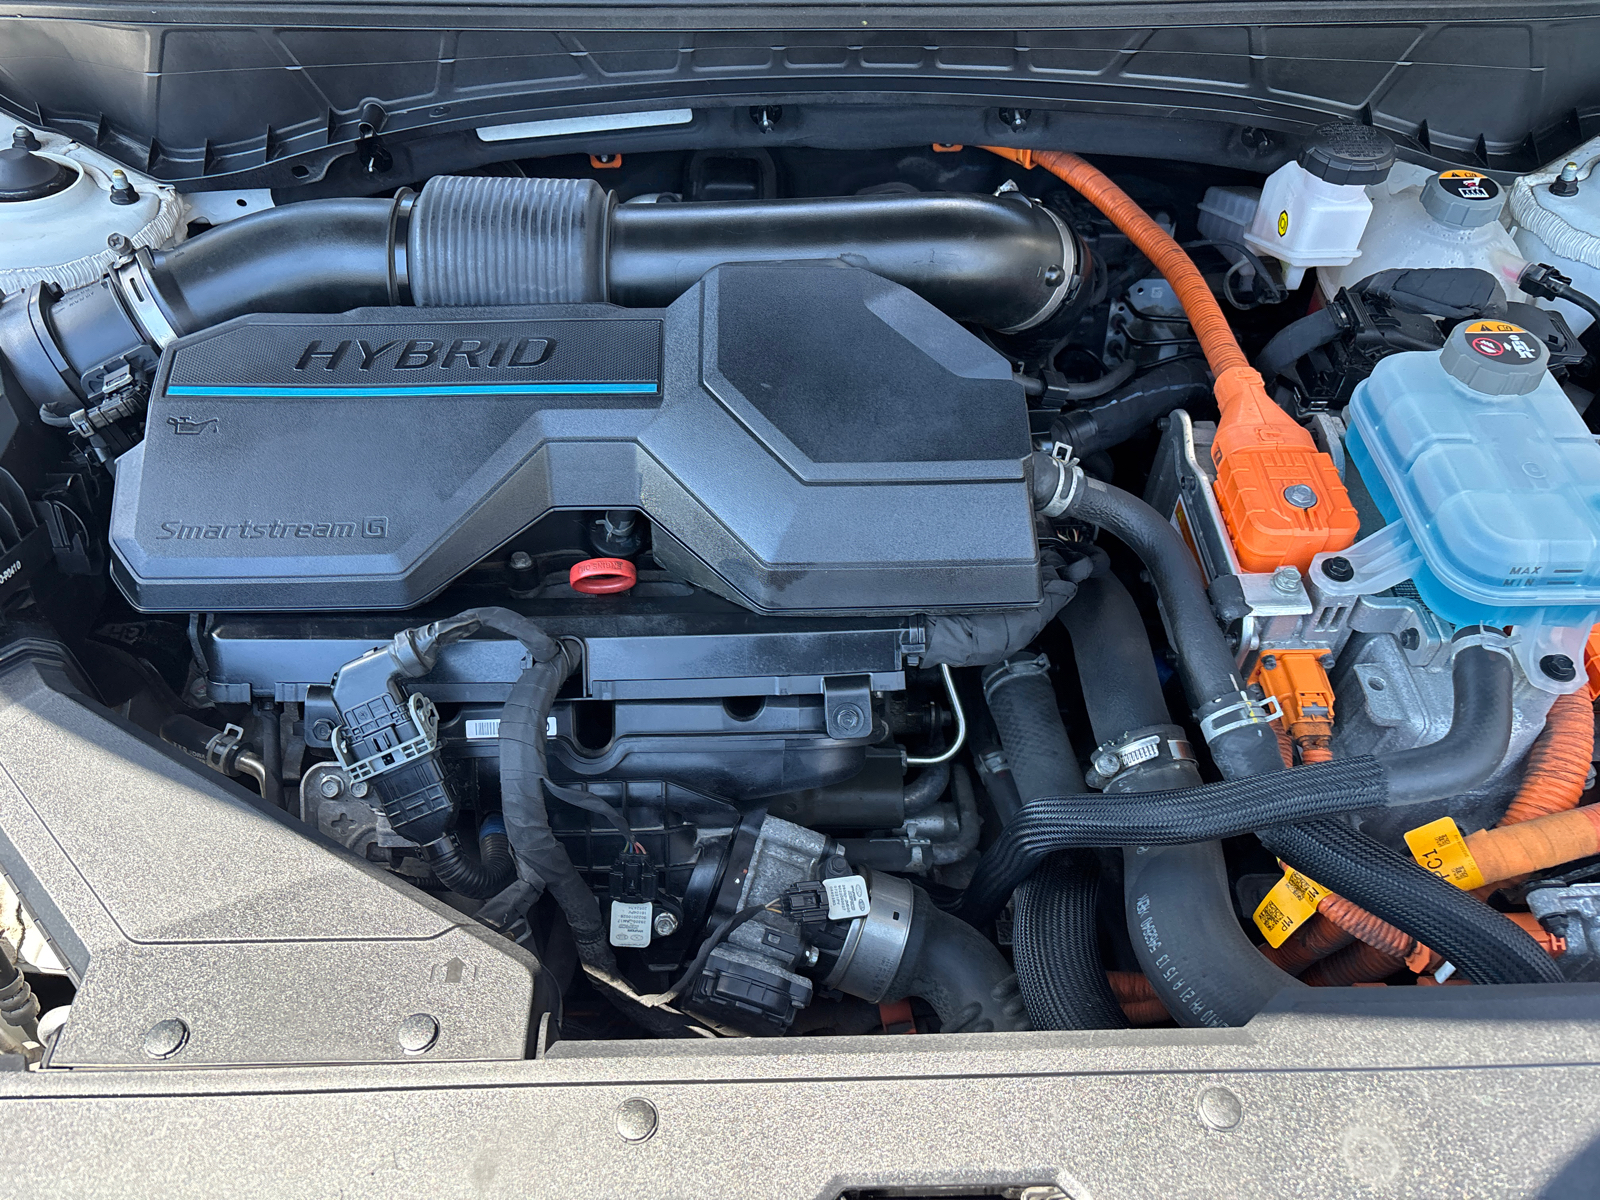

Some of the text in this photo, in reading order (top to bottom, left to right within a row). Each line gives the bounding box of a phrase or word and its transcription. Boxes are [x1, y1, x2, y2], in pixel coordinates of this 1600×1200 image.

[293, 336, 558, 371] HYBRID
[155, 519, 357, 540] Smartstream
[592, 561, 623, 571] ENGINE
[1509, 566, 1542, 575] MAX
[1502, 578, 1535, 587] MIN
[1306, 886, 1319, 903] MP
[1281, 916, 1294, 932] MP
[1155, 954, 1171, 969] 13
[1163, 966, 1179, 982] 15
[1179, 987, 1196, 1003] 21
[1188, 997, 1206, 1015] PH
